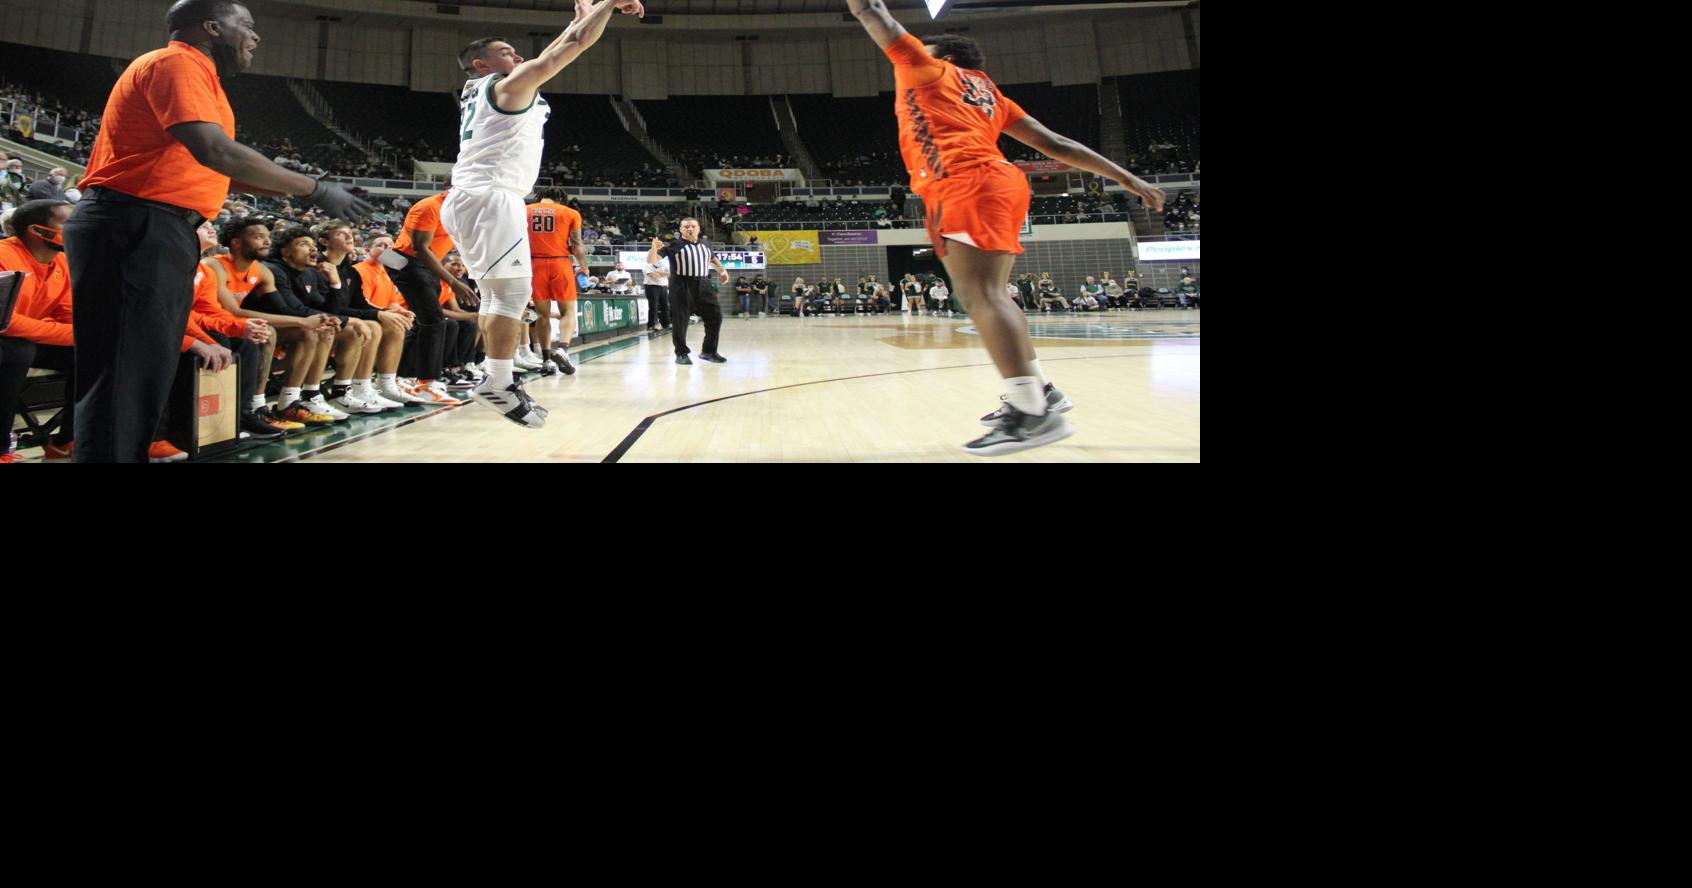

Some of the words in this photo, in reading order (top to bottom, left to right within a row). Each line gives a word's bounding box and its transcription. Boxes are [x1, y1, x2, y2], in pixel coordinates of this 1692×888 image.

[719, 169, 784, 179] QDOBA
[532, 215, 554, 232] 20
[716, 253, 743, 261] 17:54
[751, 256, 758, 264] 5
